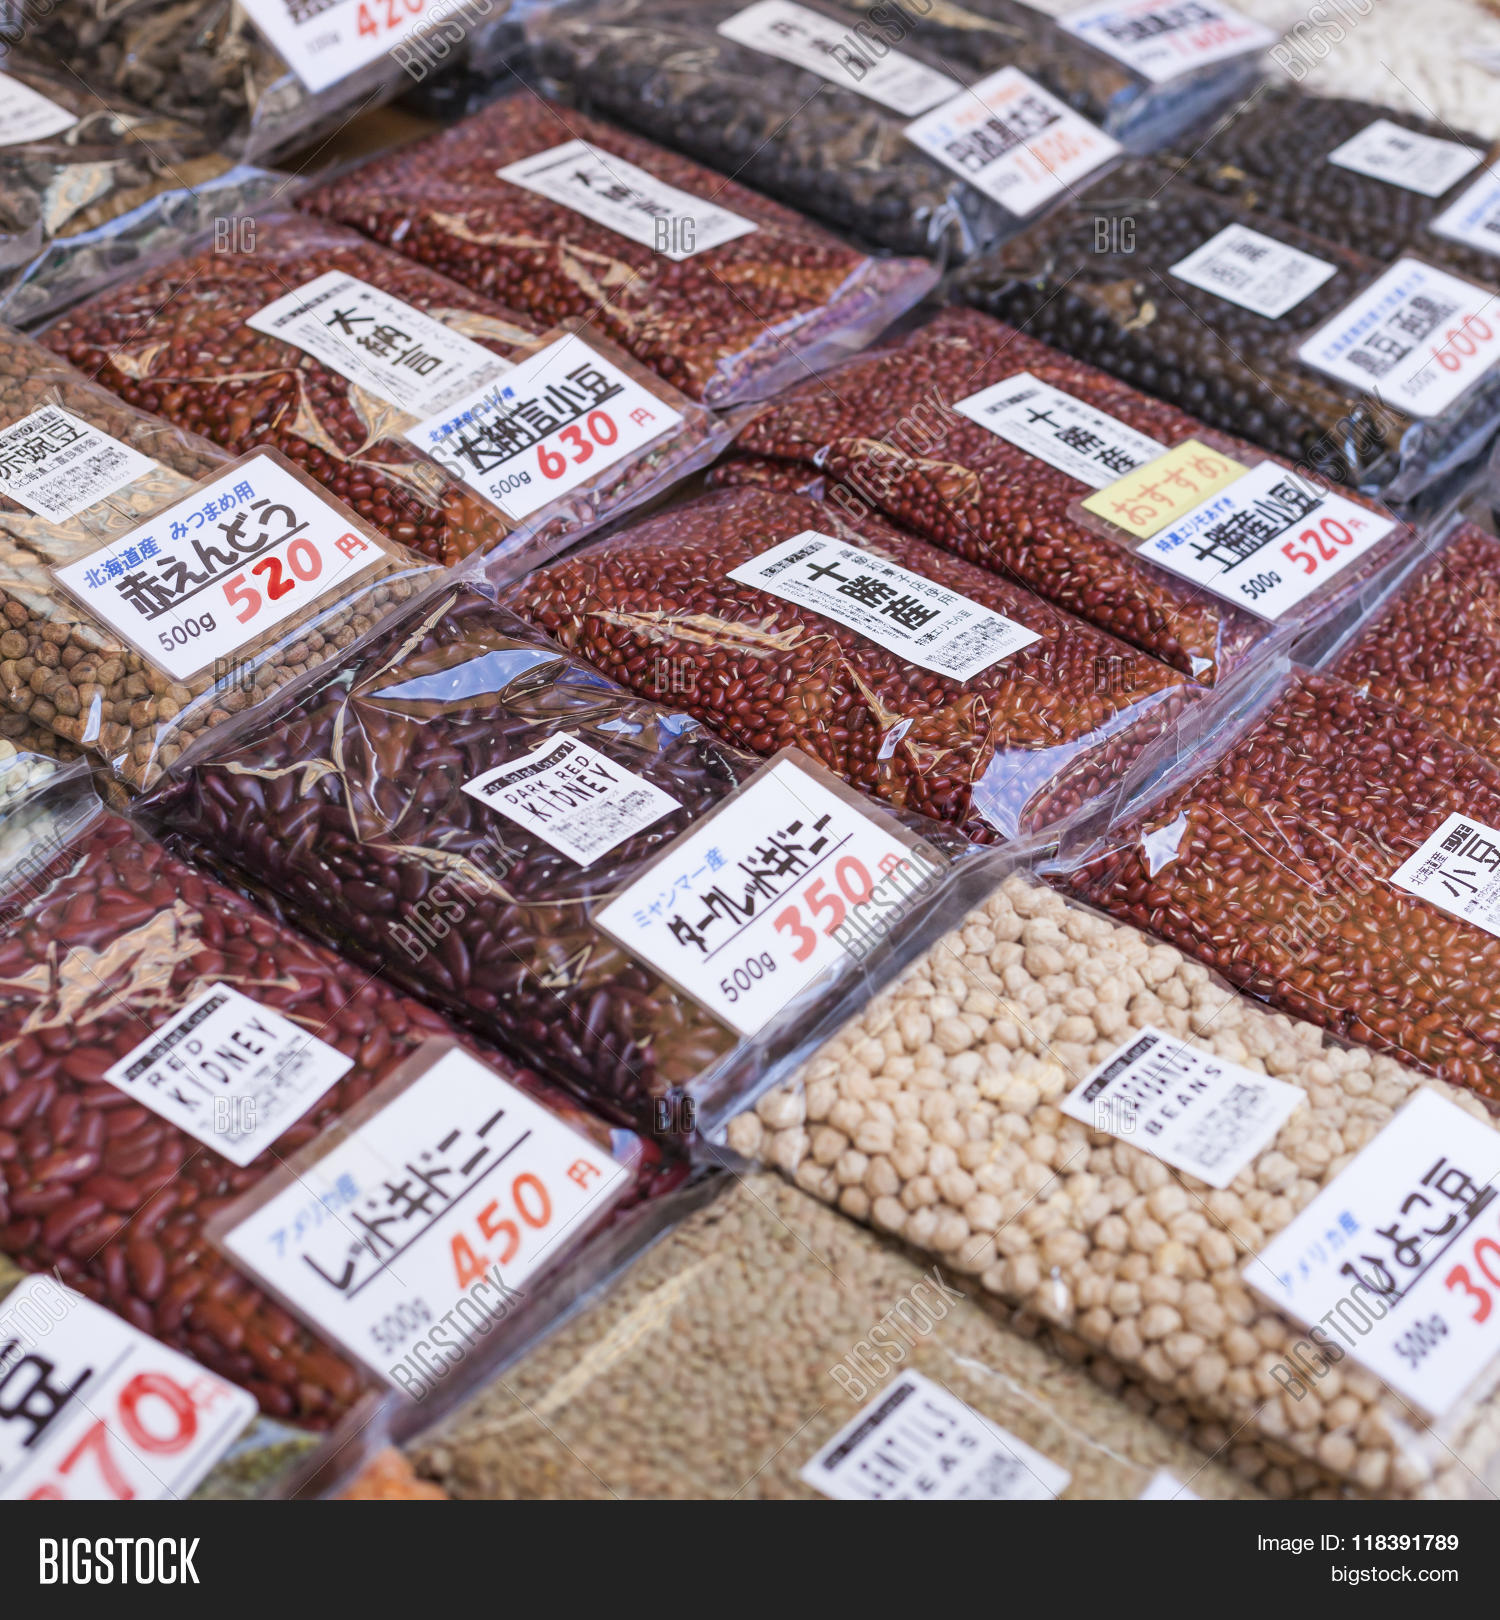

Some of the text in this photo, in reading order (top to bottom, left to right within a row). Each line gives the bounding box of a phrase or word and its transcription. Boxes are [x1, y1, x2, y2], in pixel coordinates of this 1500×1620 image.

[1431, 314, 1494, 372] 600
[489, 470, 532, 499] 500g
[536, 410, 618, 480] 630
[1111, 454, 1229, 526] おすすめ
[83, 536, 162, 590] 北海道産
[169, 480, 256, 541] みつまめ用
[115, 498, 298, 615] 赤えんどう
[1240, 570, 1283, 600] 500g
[1280, 517, 1354, 575] 520
[158, 532, 369, 652] 500g 520 円
[805, 560, 941, 630] 十勝産
[504, 755, 589, 805] DARK RED
[521, 762, 619, 822] KIDNEY
[633, 846, 728, 927] ミャンマー産
[1438, 833, 1500, 898] 小豆
[720, 952, 777, 1003] 500g
[772, 855, 874, 964] 350
[148, 1039, 203, 1087] RED
[167, 1016, 278, 1113] KIDNEY
[1144, 1064, 1222, 1136] BEANS
[302, 1109, 505, 1291] レッドキドニー
[450, 1172, 553, 1290] 450
[566, 1158, 602, 1190] 円
[27, 1371, 197, 1500] 70
